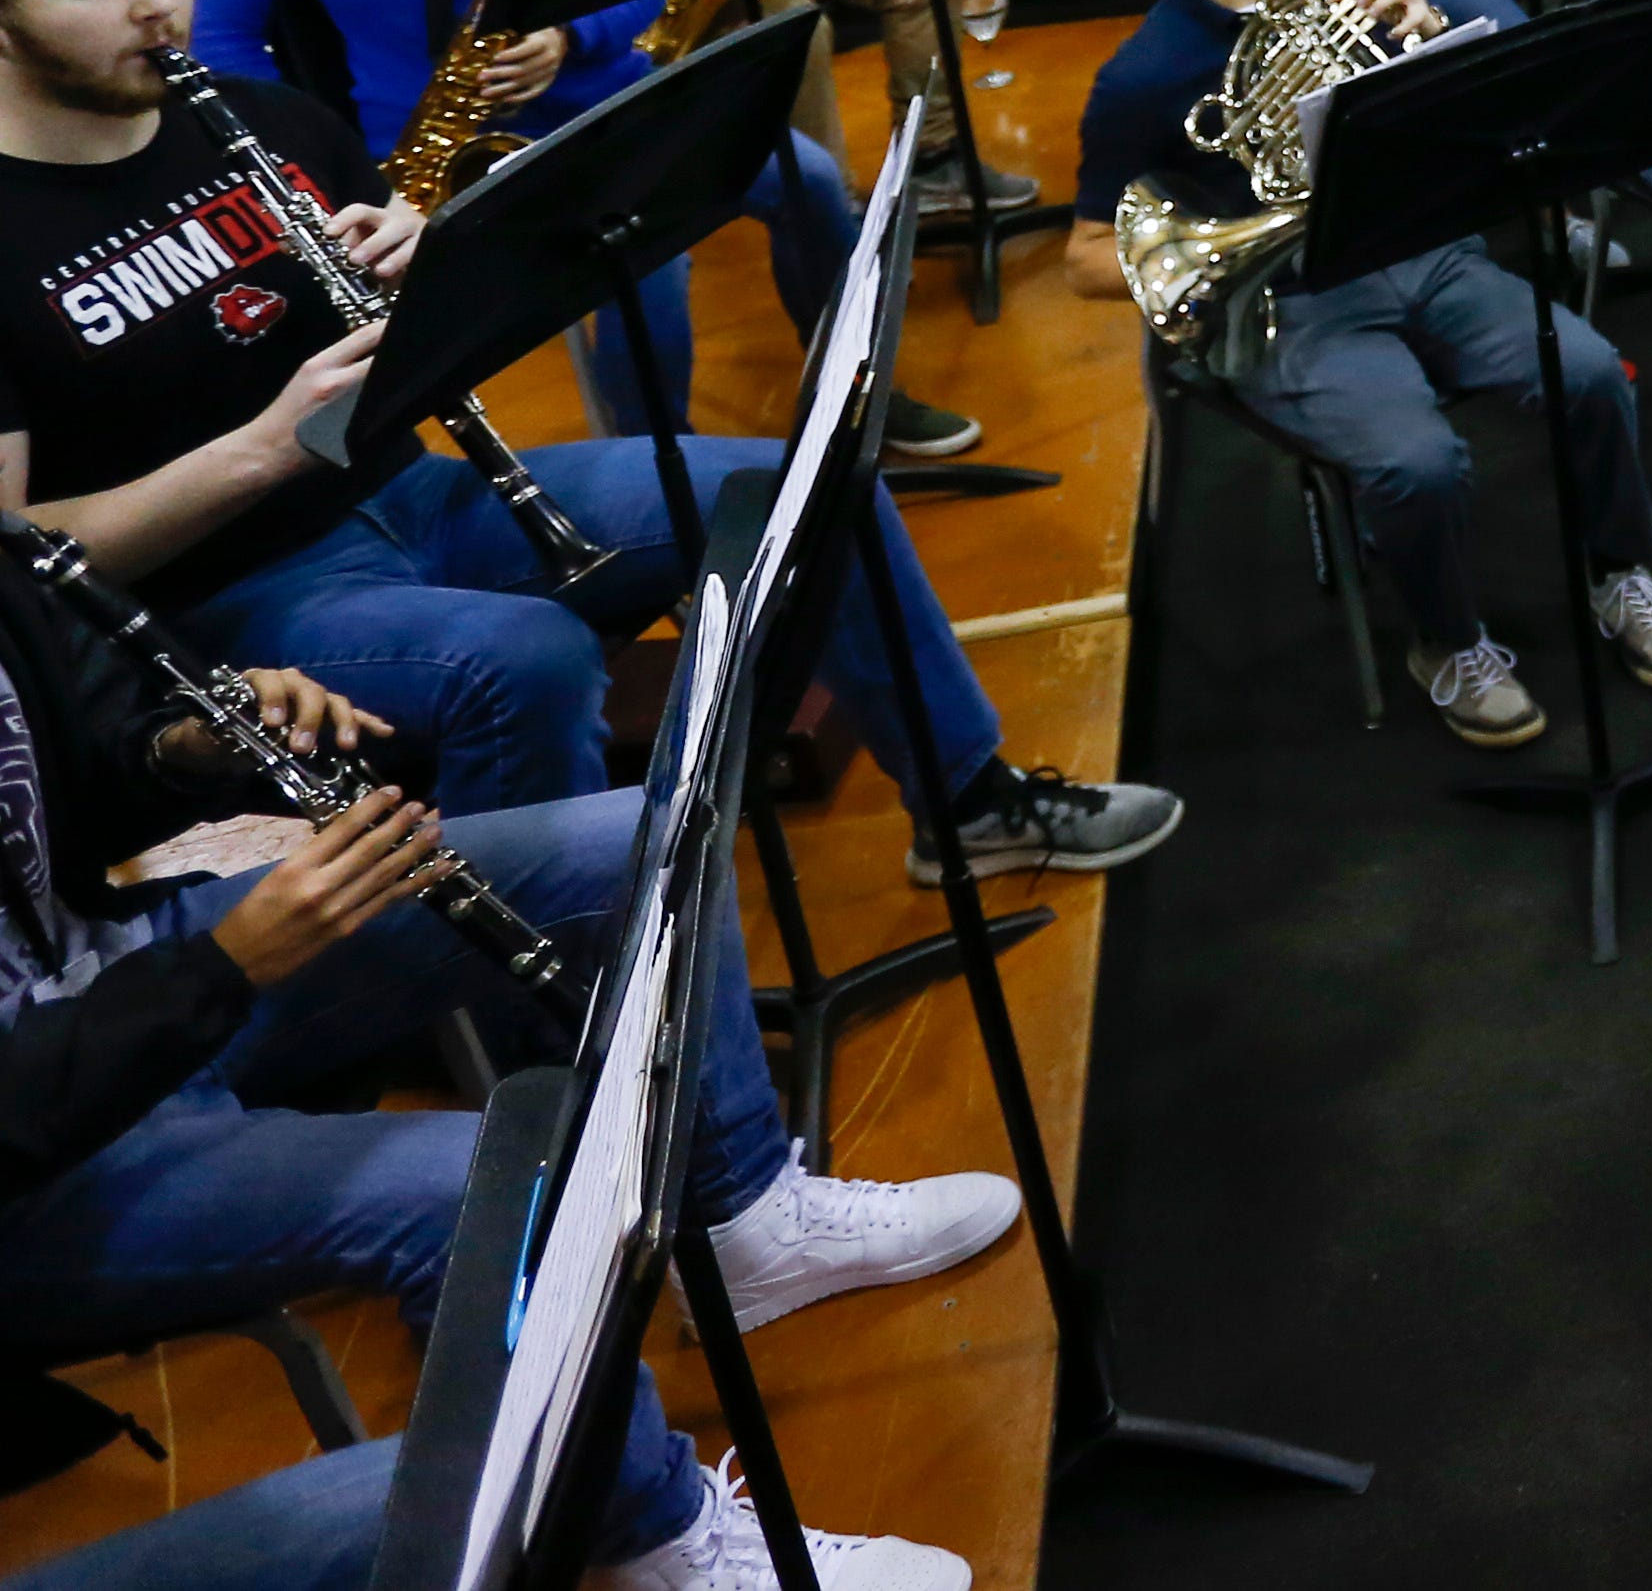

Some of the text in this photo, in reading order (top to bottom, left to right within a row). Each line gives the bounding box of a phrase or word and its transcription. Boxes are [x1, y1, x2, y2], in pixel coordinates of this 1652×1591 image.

[40, 153, 285, 290] CENTRAL BULLDS
[61, 218, 236, 346] SWIM
